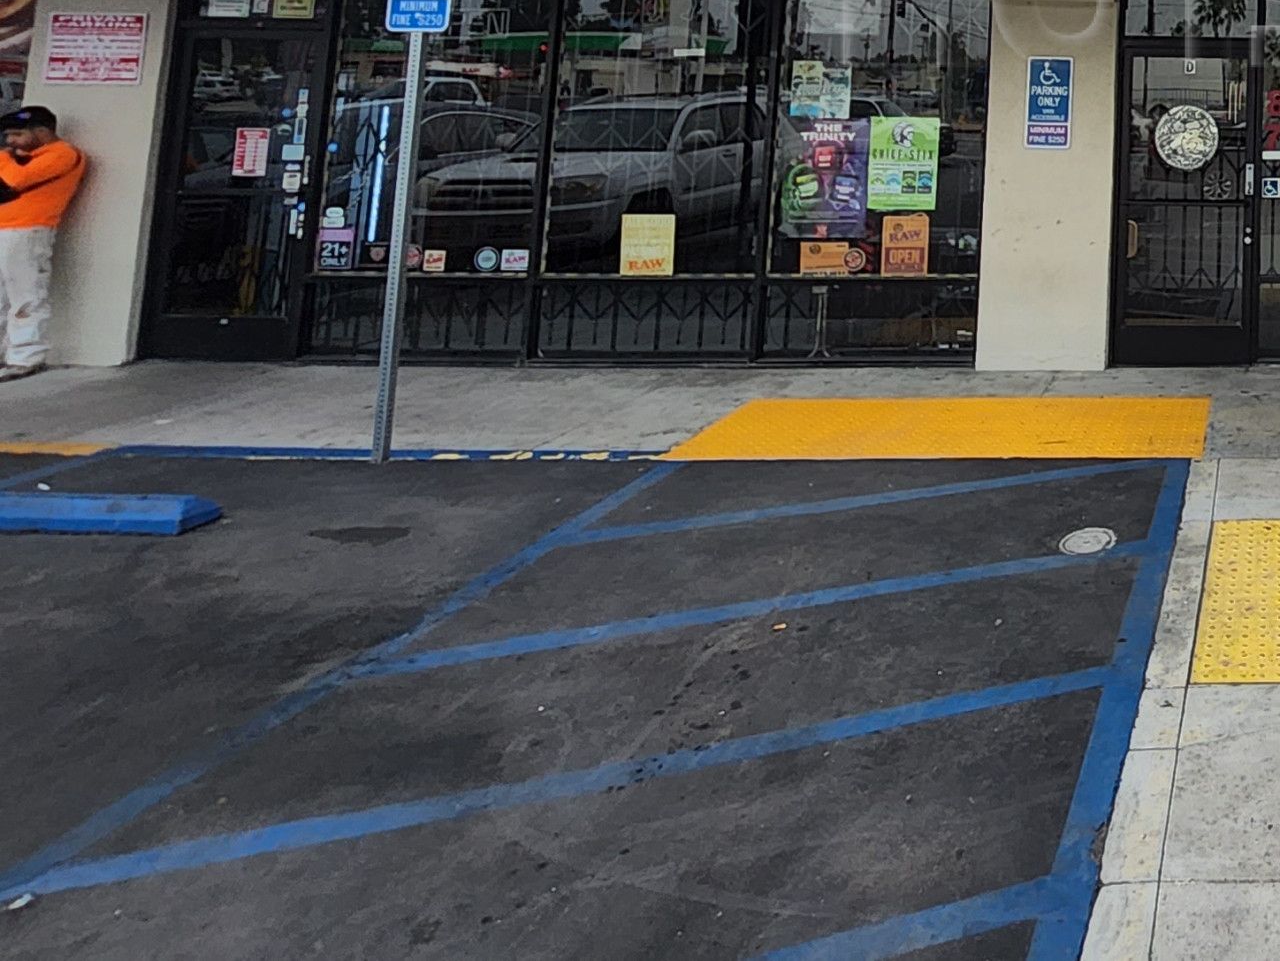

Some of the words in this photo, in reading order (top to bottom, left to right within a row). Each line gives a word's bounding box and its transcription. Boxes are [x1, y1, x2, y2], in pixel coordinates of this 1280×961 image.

[399, 0, 439, 13] MINIMUM
[391, 13, 412, 26] FINE
[415, 13, 444, 26] $250
[1030, 85, 1069, 97] PARKING
[1036, 96, 1061, 108] ONLY
[814, 123, 844, 133] THE
[1029, 126, 1066, 134] MINIMUM
[799, 131, 857, 142] TRINITY
[1028, 135, 1046, 143] FINE
[321, 242, 349, 257] 21+
[320, 257, 347, 267] ONLY
[889, 248, 922, 264] OPEN
[627, 257, 666, 271] RAW
